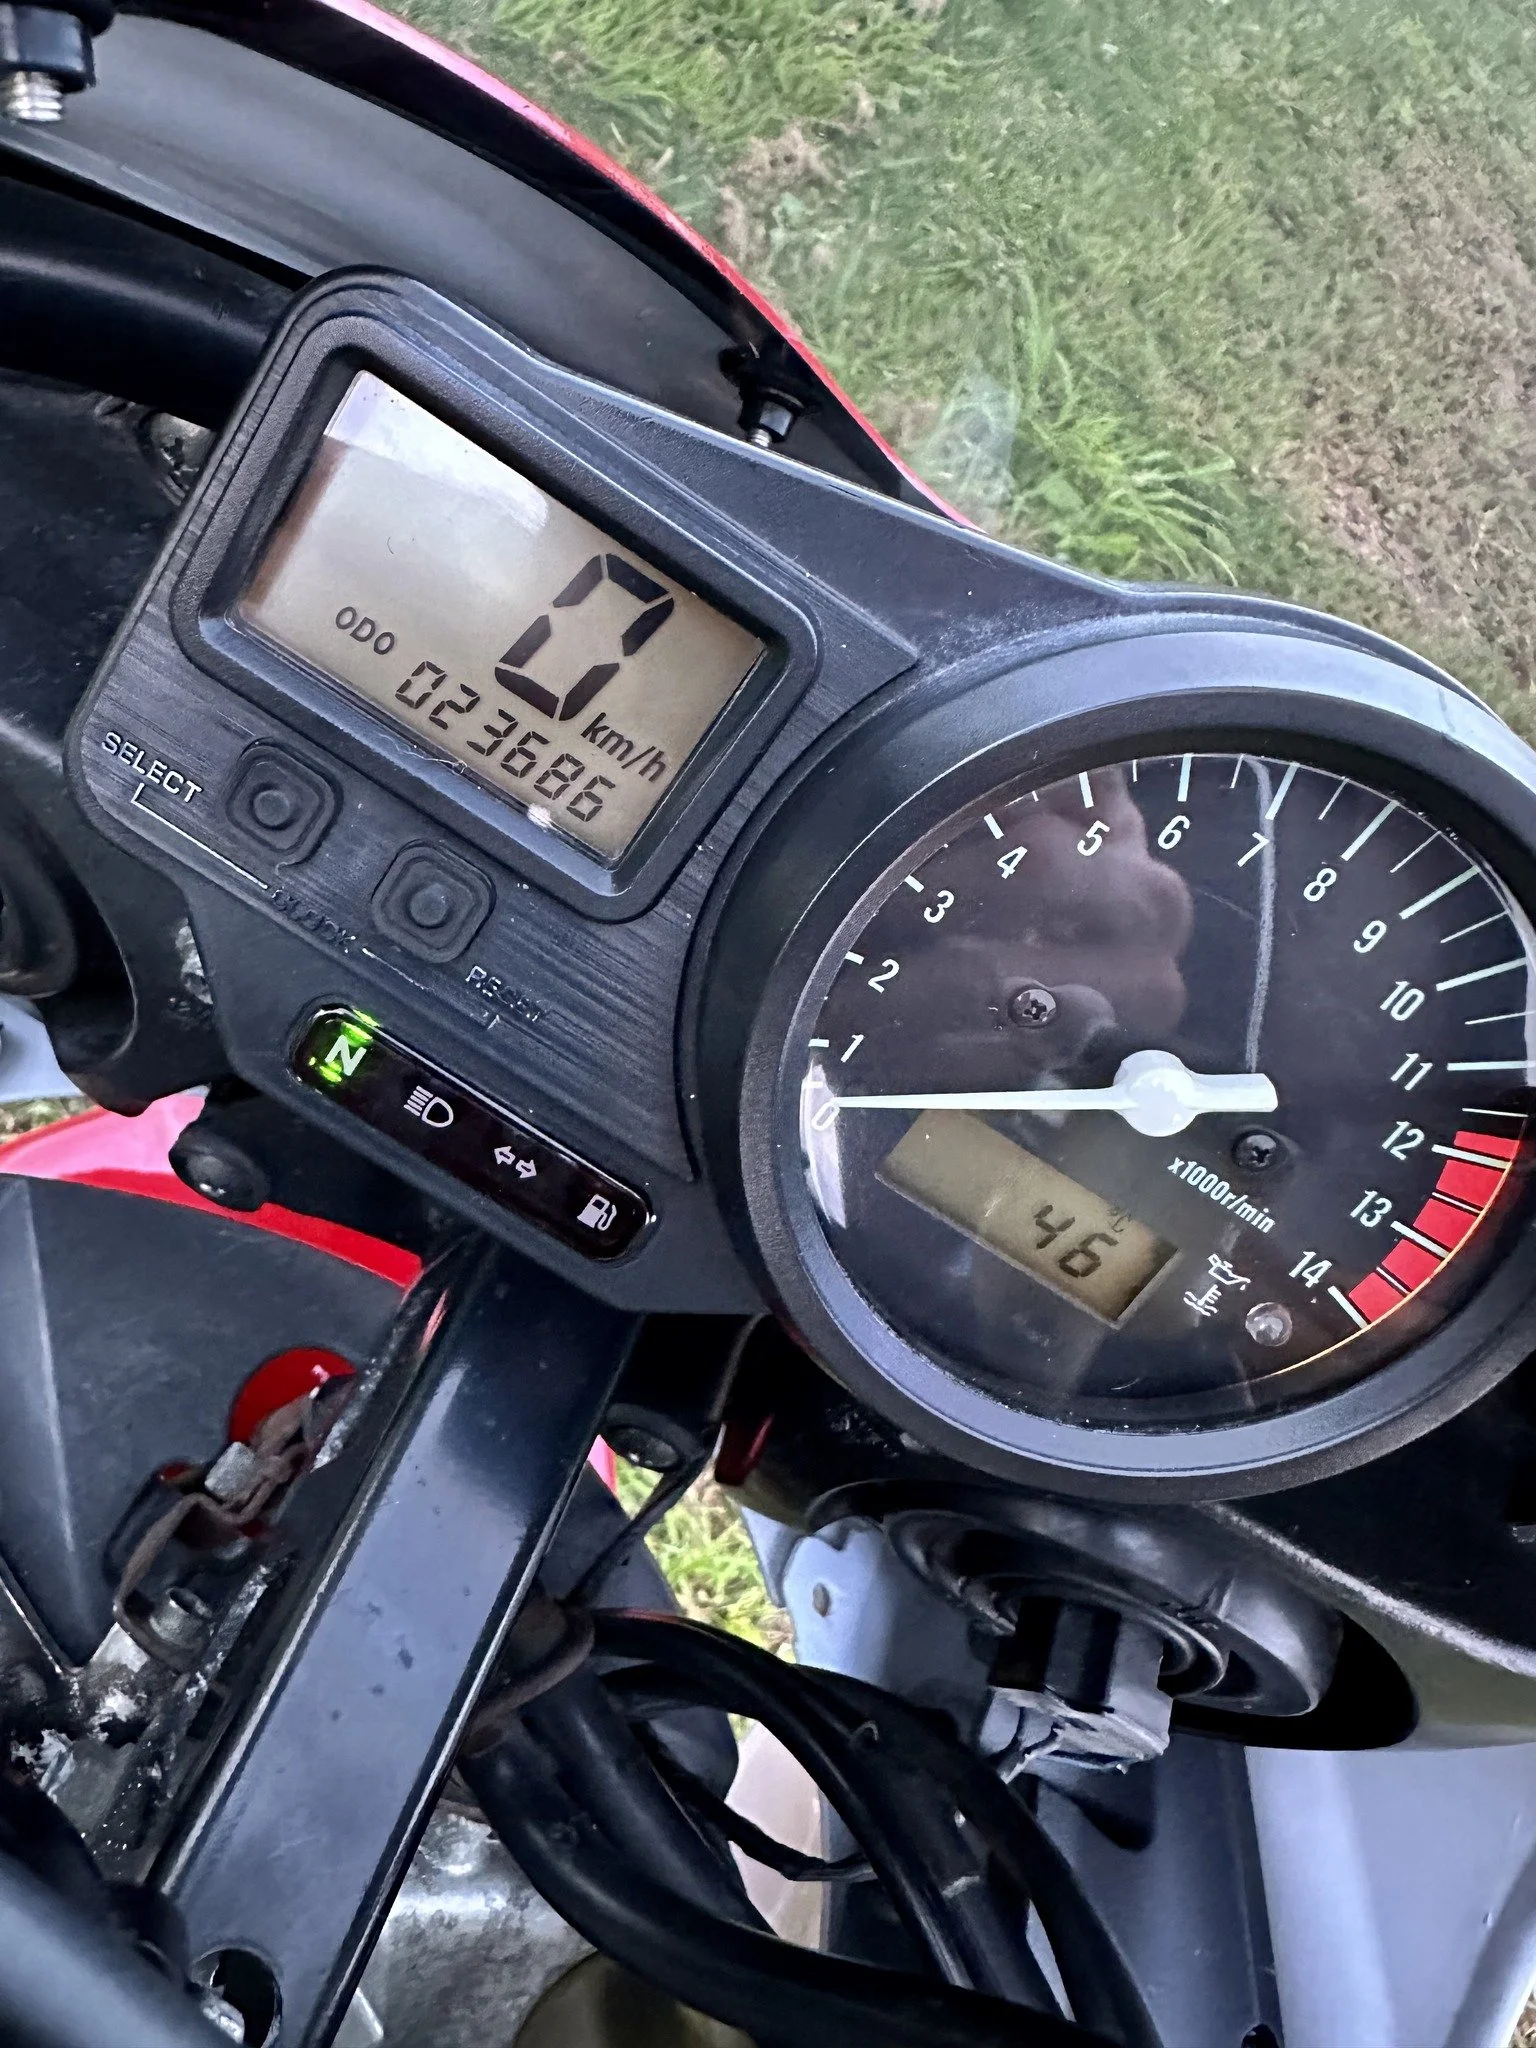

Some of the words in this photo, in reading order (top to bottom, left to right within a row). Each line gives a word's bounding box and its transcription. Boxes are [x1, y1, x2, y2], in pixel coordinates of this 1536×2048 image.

[335, 606, 395, 656] ODO
[494, 552, 675, 722] 0
[395, 660, 616, 823] 023686
[580, 712, 667, 783] km/h
[101, 731, 203, 803] SELECT
[1077, 820, 1110, 857] 5
[1157, 815, 1191, 850] 6
[1237, 831, 1270, 868] 7
[996, 846, 1029, 880] 4
[1303, 867, 1338, 902] 8
[923, 889, 955, 924] 3
[1353, 919, 1388, 954] 9
[867, 958, 900, 994] 2
[1379, 980, 1426, 1022] 10
[324, 1034, 368, 1077] N
[840, 1034, 865, 1063] 1
[1390, 1053, 1434, 1092] 11
[811, 1097, 840, 1132] 0
[1381, 1120, 1426, 1161] 12
[1166, 1156, 1276, 1234] x1000r/min
[1350, 1189, 1393, 1228] 13
[1032, 1203, 1120, 1279] 46
[1288, 1250, 1333, 1289] 14
